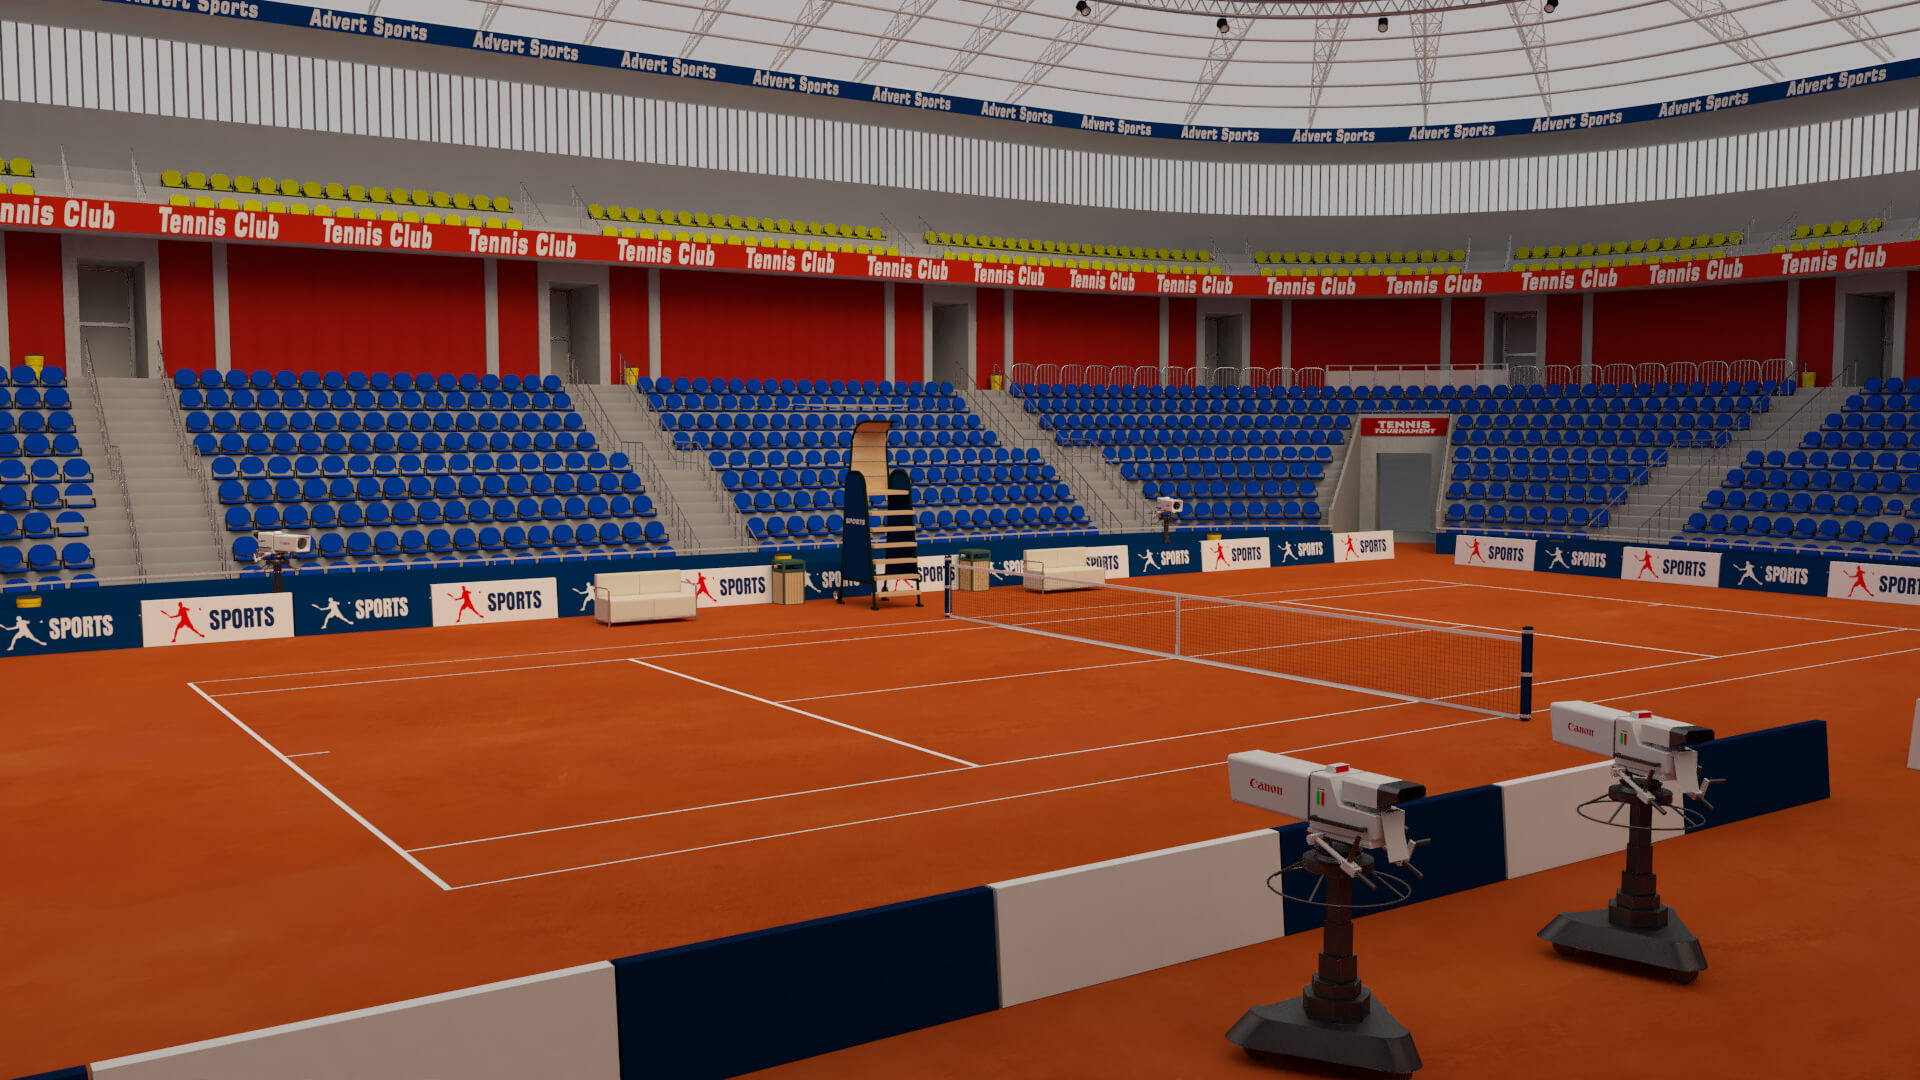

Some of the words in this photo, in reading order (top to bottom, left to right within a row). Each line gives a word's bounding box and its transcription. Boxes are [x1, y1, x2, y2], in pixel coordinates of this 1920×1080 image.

[197, 0, 259, 18] Sports
[309, 9, 367, 33] Advert
[373, 16, 428, 41] Sports
[473, 31, 525, 55] Advert
[530, 40, 579, 61] Sports
[621, 51, 667, 73] Advert
[672, 58, 716, 80] Sports
[753, 70, 795, 90] Advert
[799, 76, 839, 96] Sports
[1787, 77, 1833, 96] Advert
[1838, 69, 1887, 88] Sports
[872, 87, 911, 105] Advert
[914, 93, 951, 111] Sports
[1659, 100, 1701, 118] Advert
[1706, 93, 1749, 111] Sports
[981, 102, 1017, 119] Advert
[1019, 108, 1053, 125] Sports
[1532, 116, 1576, 132] Advert
[1580, 112, 1622, 128] Sports
[1081, 115, 1116, 131] Advert
[1118, 120, 1152, 136] Sports
[1181, 125, 1218, 140] Advert
[1221, 128, 1259, 142] Sports
[1409, 126, 1449, 141] Advert
[1454, 125, 1495, 139] Sports
[1292, 131, 1332, 143] Advert
[1336, 131, 1375, 144] Sports
[64, 200, 115, 229] Club
[159, 207, 225, 236] Tennis
[235, 212, 278, 239] Club
[323, 219, 382, 246] Tennis
[391, 223, 432, 249] Club
[469, 228, 528, 255] Tennis
[536, 233, 576, 258] Club
[618, 238, 671, 263] Tennis
[679, 243, 715, 266] Club
[747, 248, 795, 271] Tennis
[802, 252, 834, 274] Club
[1782, 251, 1837, 275] Tennis
[1845, 246, 1887, 269] Club
[868, 256, 912, 278] Tennis
[918, 259, 949, 280] Club
[974, 263, 1013, 284] Tennis
[1019, 267, 1045, 286] Club
[1650, 262, 1700, 285] Tennis
[1707, 258, 1744, 280] Club
[1070, 270, 1105, 289] Tennis
[1110, 272, 1134, 291] Club
[1157, 275, 1196, 293] Tennis
[1202, 276, 1233, 294] Club
[1267, 276, 1315, 295] Tennis
[1321, 277, 1356, 295] Club
[1387, 276, 1437, 294] Tennis
[1445, 275, 1482, 294] Club
[1521, 271, 1574, 291] Tennis
[1581, 268, 1618, 288] Club
[1378, 420, 1431, 429] TENNIS
[1160, 549, 1190, 565] SPORTS
[1231, 546, 1262, 562] SPORTS
[1298, 541, 1323, 556] SPORTS
[1360, 539, 1386, 553] SPORTS
[1488, 546, 1524, 562] SPORTS
[1571, 551, 1607, 568] SPORTS
[1662, 559, 1706, 577] SPORTS
[1765, 565, 1809, 585] SPORTS
[719, 576, 766, 598] SPORTS
[355, 597, 409, 620] SPORTS
[487, 590, 542, 612] SPORTS
[49, 615, 114, 640] SPORTS
[209, 606, 275, 631] SPORTS
[1567, 721, 1594, 737] Canon
[1249, 778, 1283, 796] Canon
